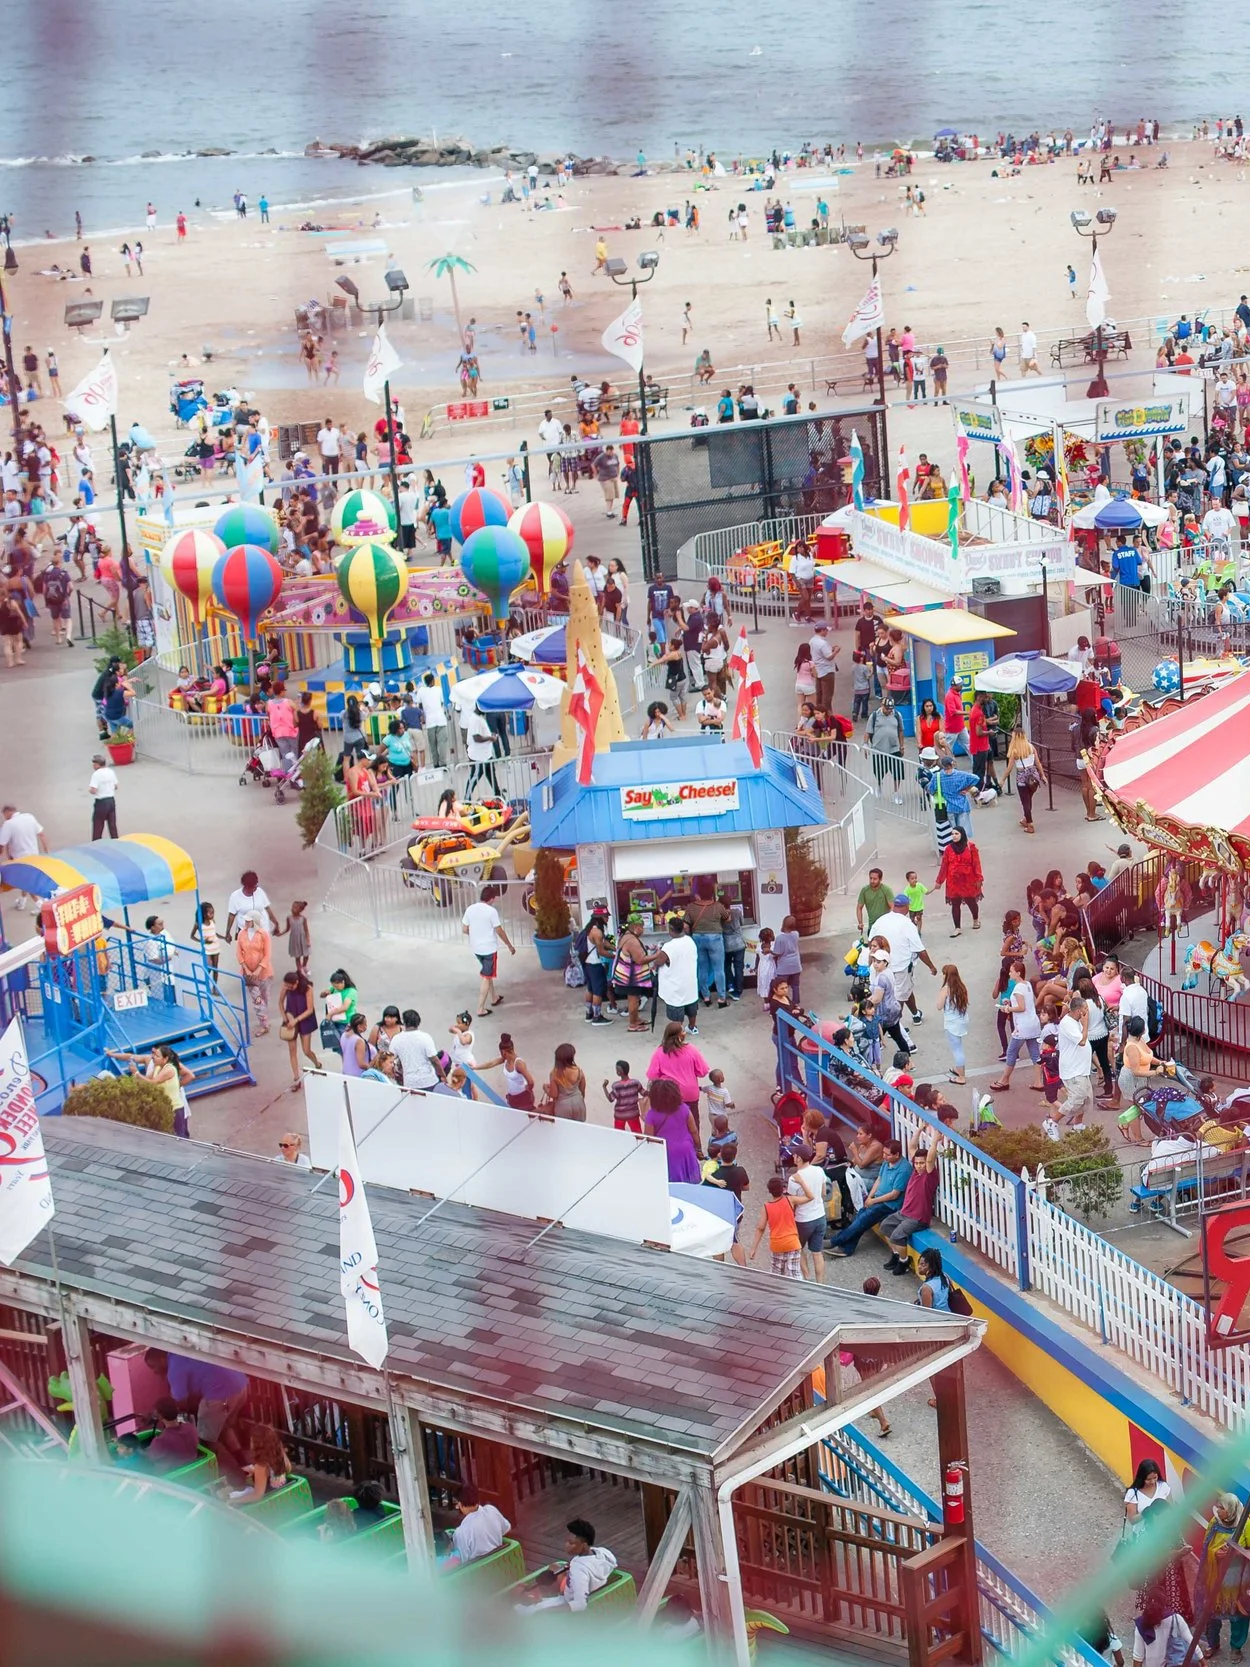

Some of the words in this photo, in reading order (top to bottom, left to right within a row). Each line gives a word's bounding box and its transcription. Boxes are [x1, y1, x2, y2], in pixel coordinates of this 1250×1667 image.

[1117, 550, 1136, 559] STAFF
[625, 790, 652, 807] Say
[679, 782, 736, 800] Cheese!
[117, 992, 144, 1008] EXIT
